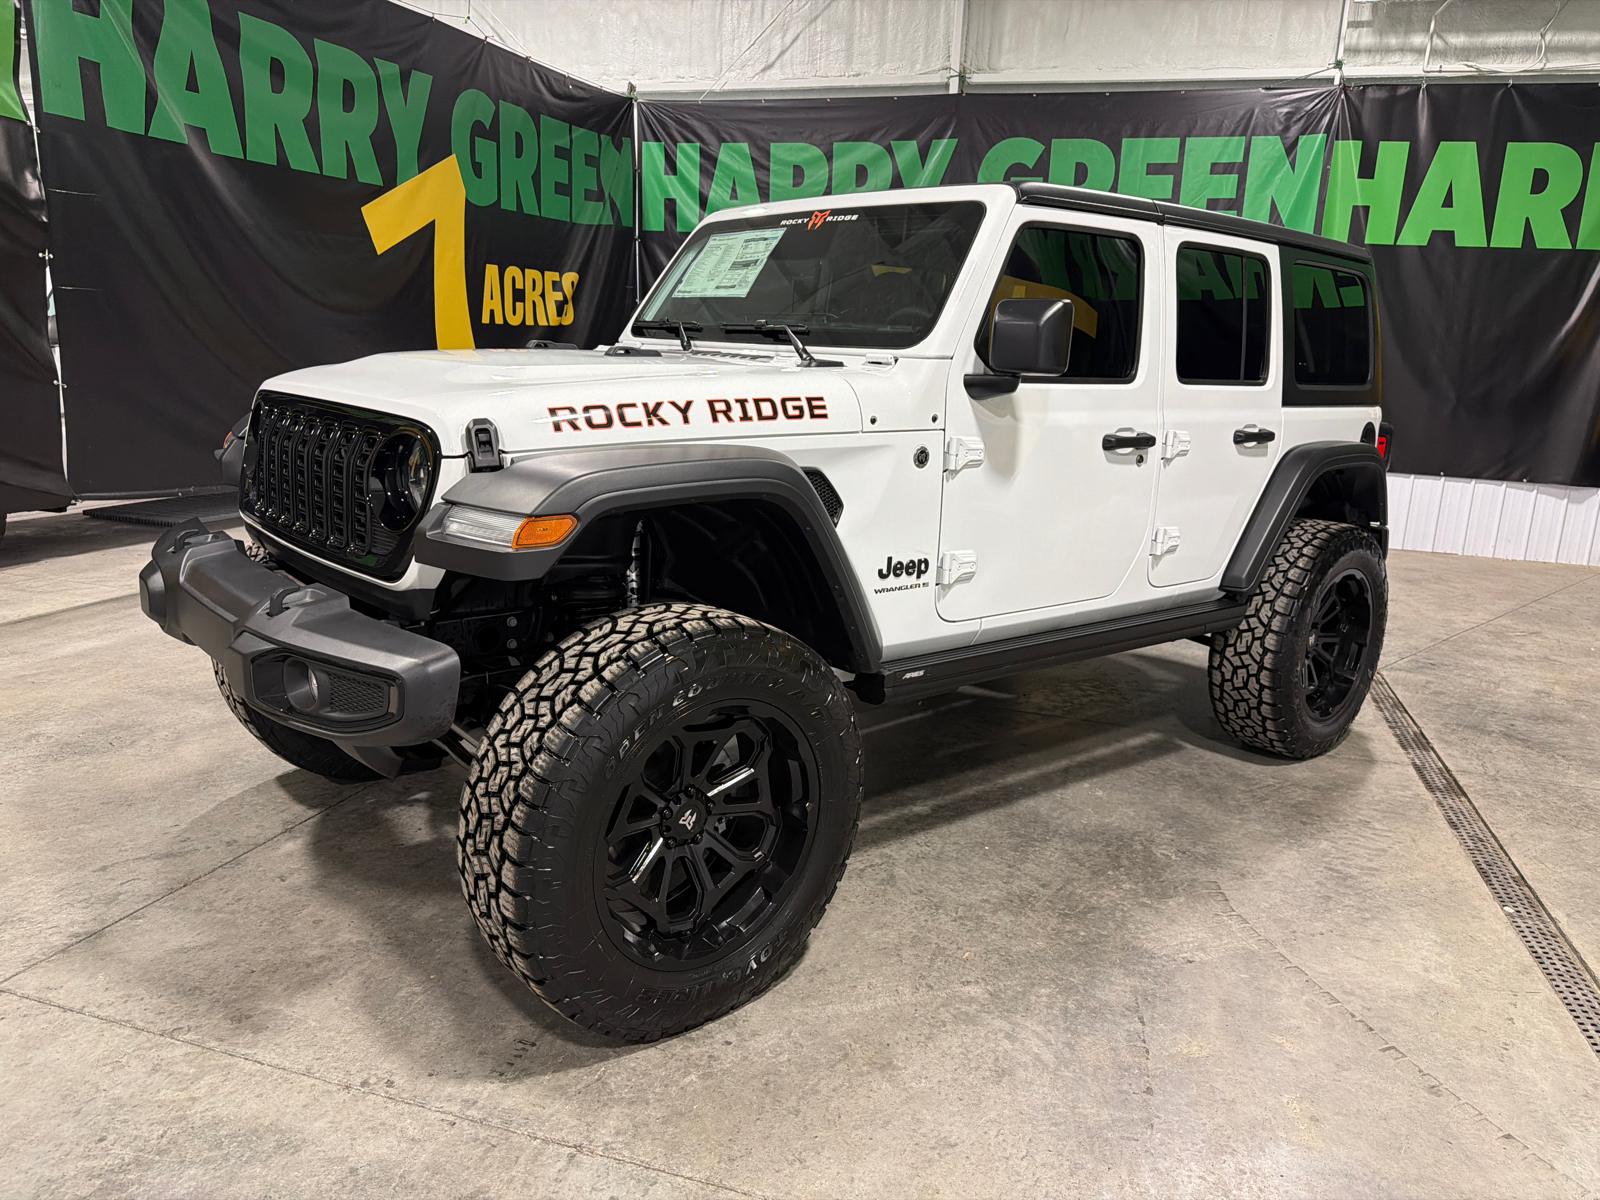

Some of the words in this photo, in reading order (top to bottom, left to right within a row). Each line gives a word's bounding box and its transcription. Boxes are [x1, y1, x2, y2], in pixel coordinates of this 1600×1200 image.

[34, 0, 433, 187] HARRY
[450, 88, 634, 228] GREEN
[1321, 140, 1600, 250] HAR
[780, 217, 810, 226] ROCKY
[825, 214, 859, 222] RIDGE
[360, 153, 476, 350] 7
[481, 263, 580, 326] ACRES
[547, 399, 694, 433] ROCKY
[706, 396, 829, 424] RIDGE
[877, 555, 930, 580] Jeep
[873, 582, 921, 595] WRANGLER
